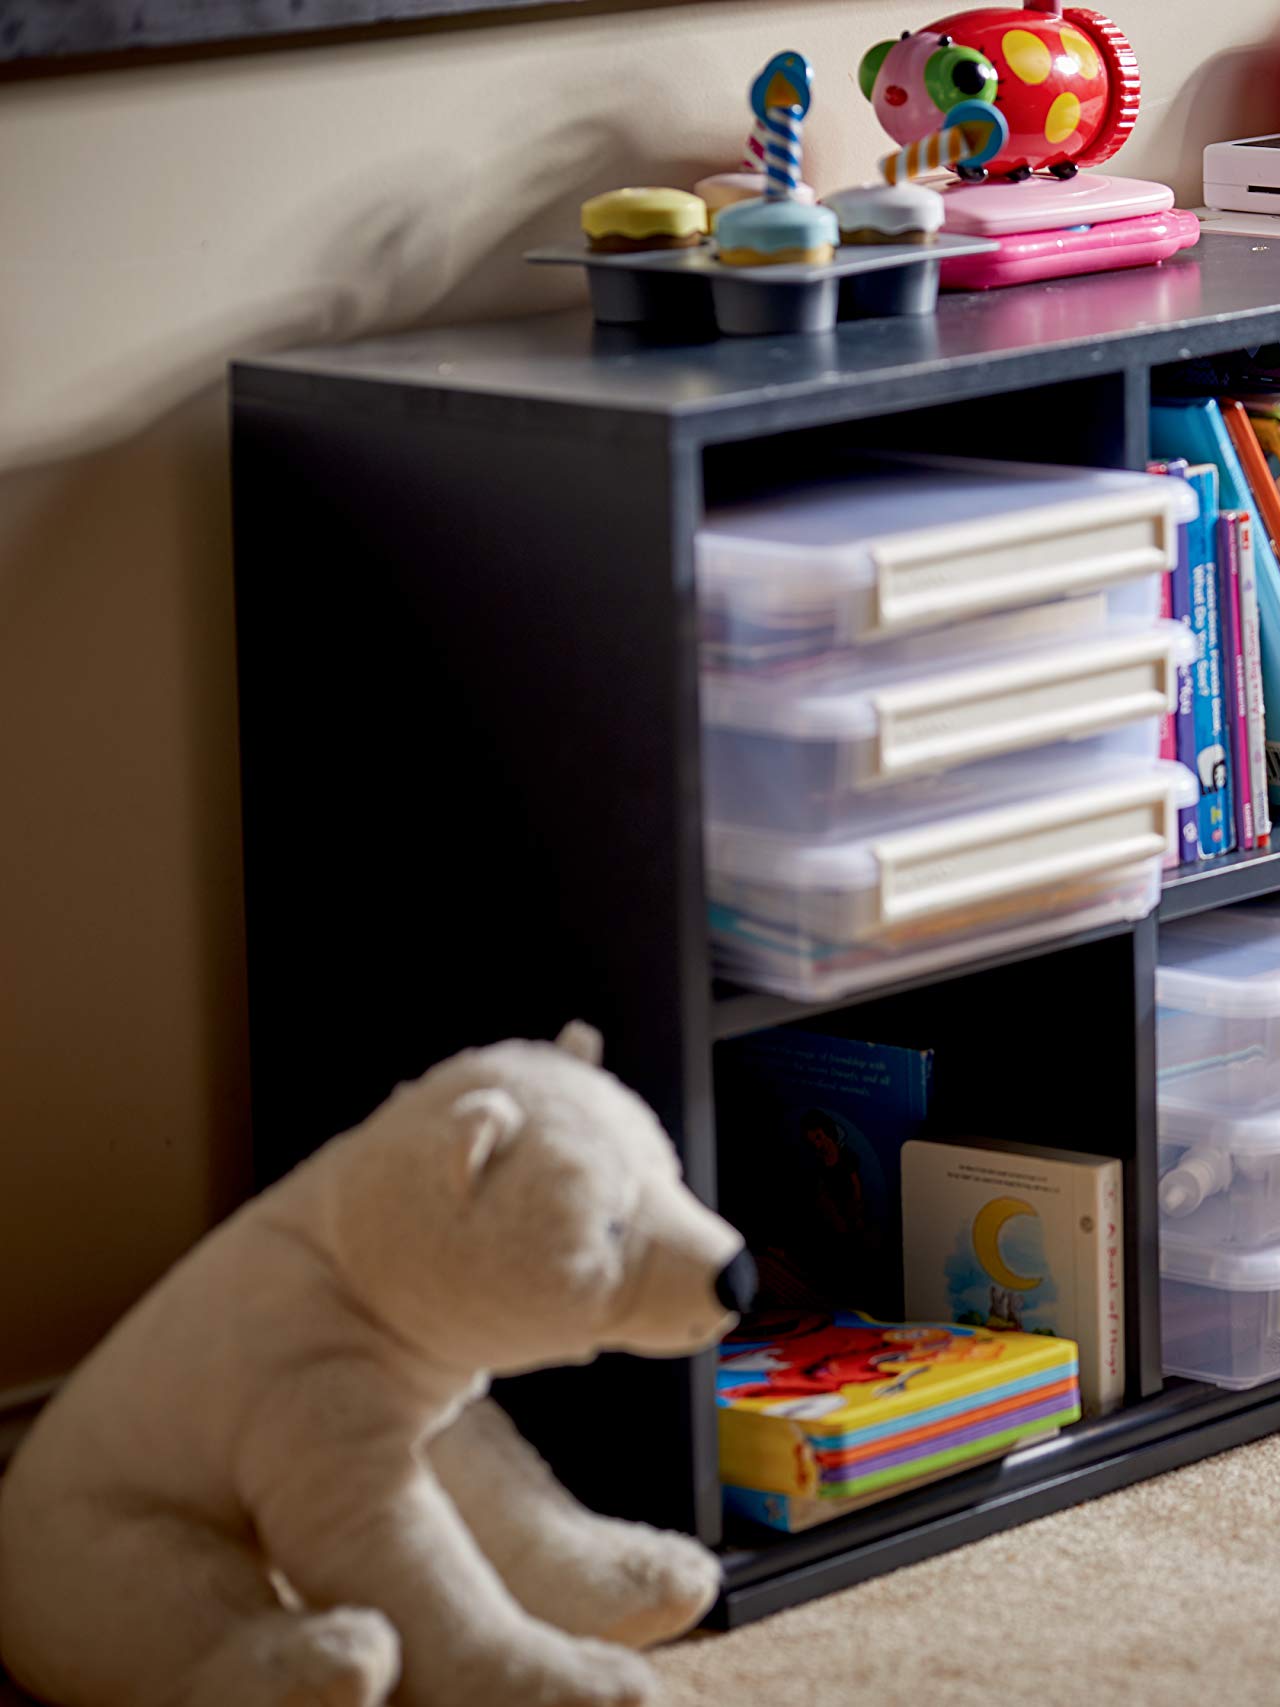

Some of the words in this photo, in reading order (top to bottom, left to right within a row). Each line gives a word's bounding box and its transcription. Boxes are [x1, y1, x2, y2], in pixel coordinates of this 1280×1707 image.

[1193, 564, 1206, 604] What
[1205, 561, 1216, 608] Panda
[1210, 648, 1220, 696] Panda
